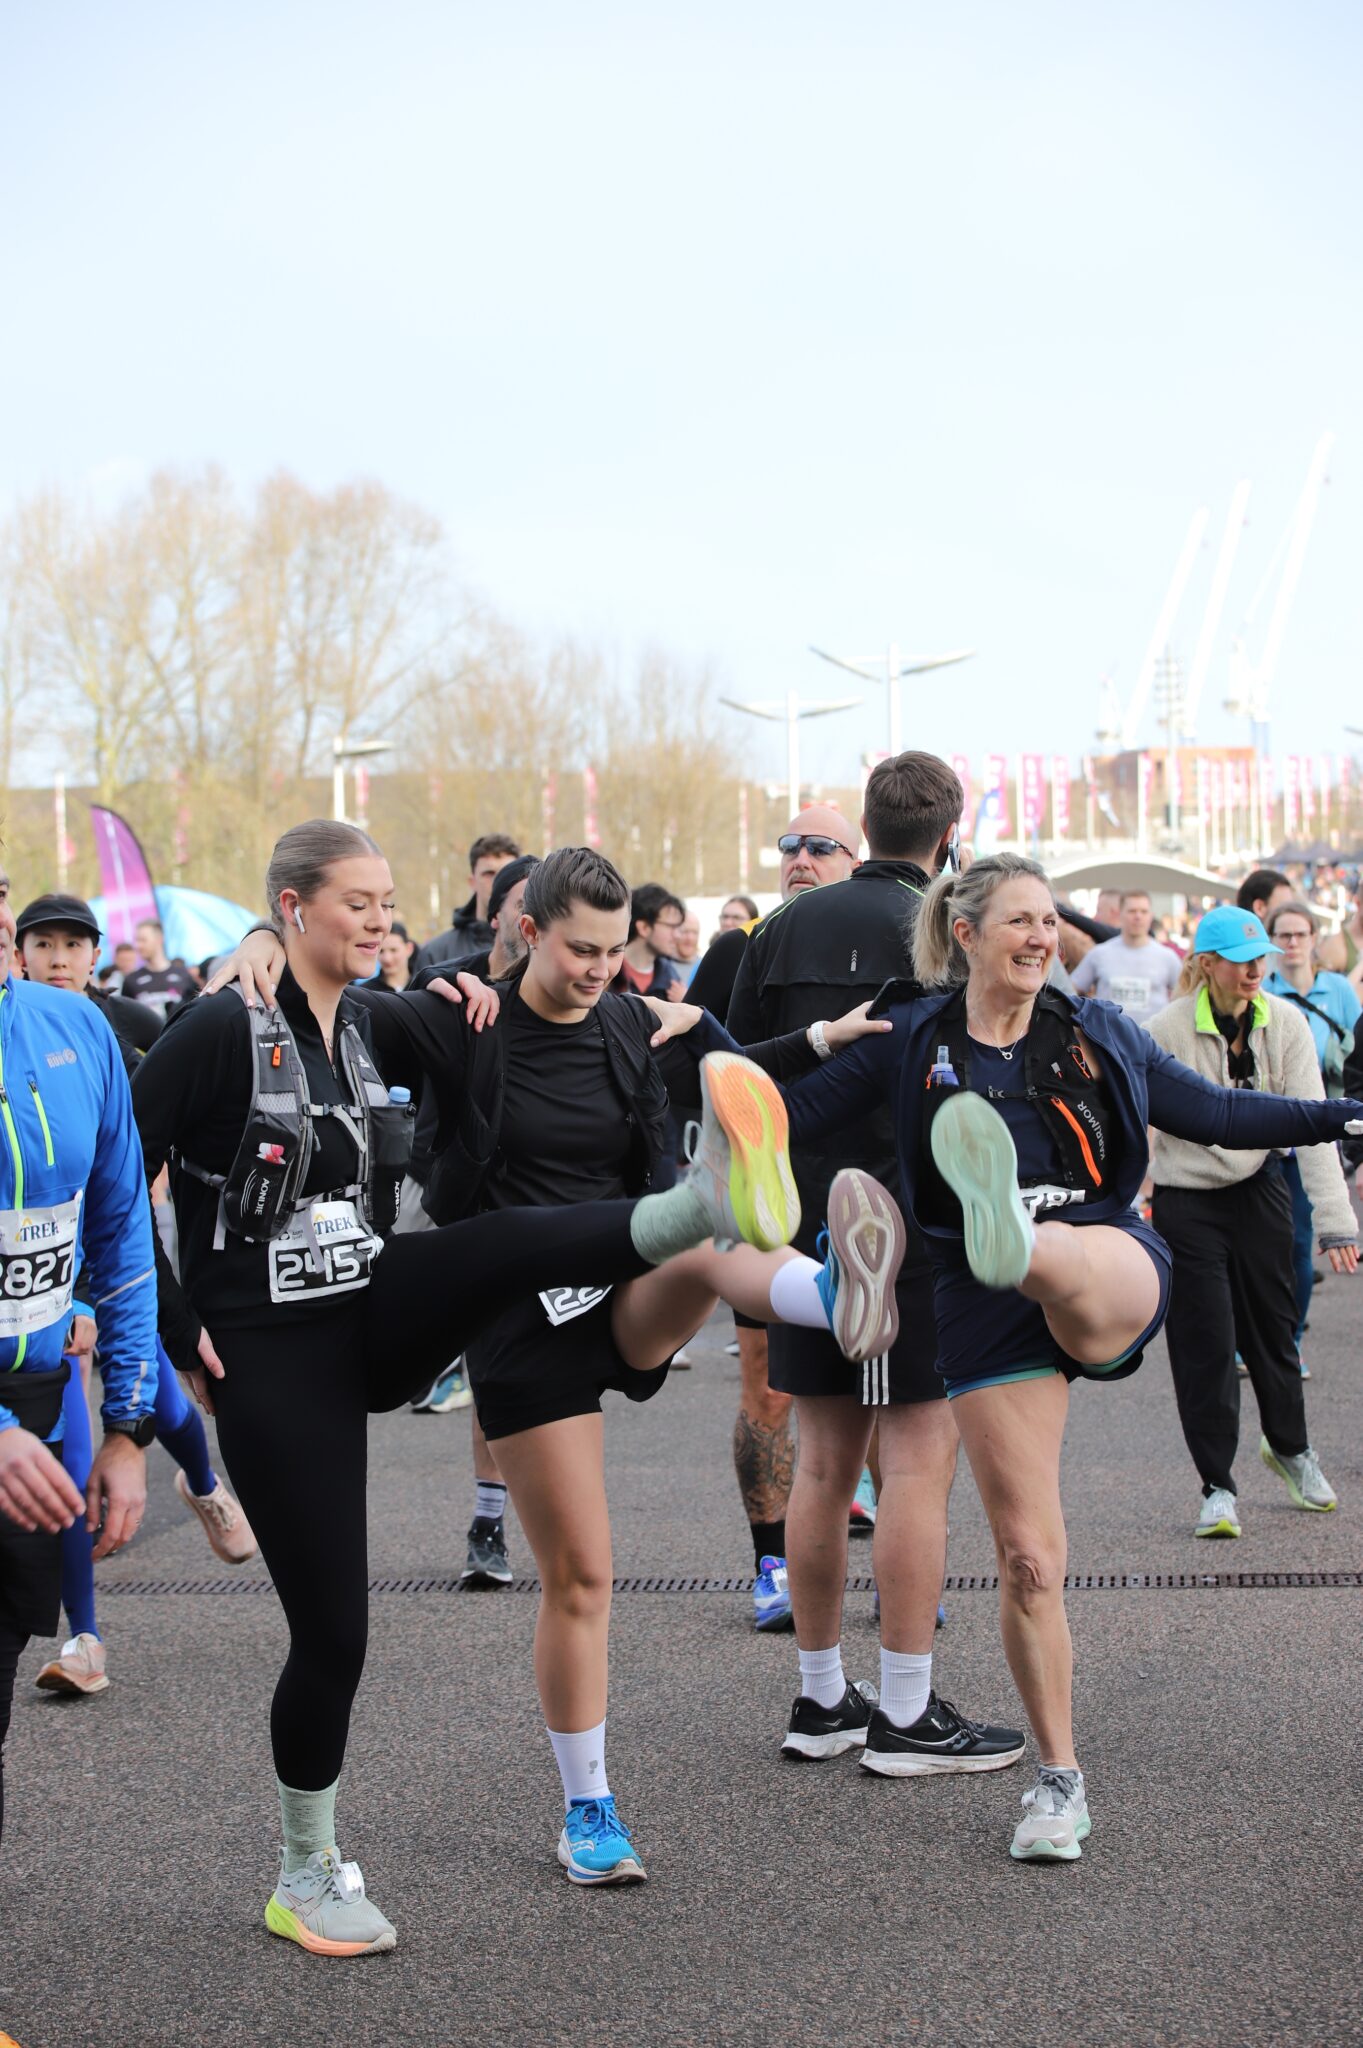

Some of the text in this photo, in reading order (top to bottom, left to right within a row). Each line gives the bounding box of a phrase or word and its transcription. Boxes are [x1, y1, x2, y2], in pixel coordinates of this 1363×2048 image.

[1077, 1100, 1106, 1160] KARRIMOR
[254, 1177, 271, 1216] AONIJIE
[20, 1221, 60, 1242] TREK
[314, 1217, 354, 1235] TREK
